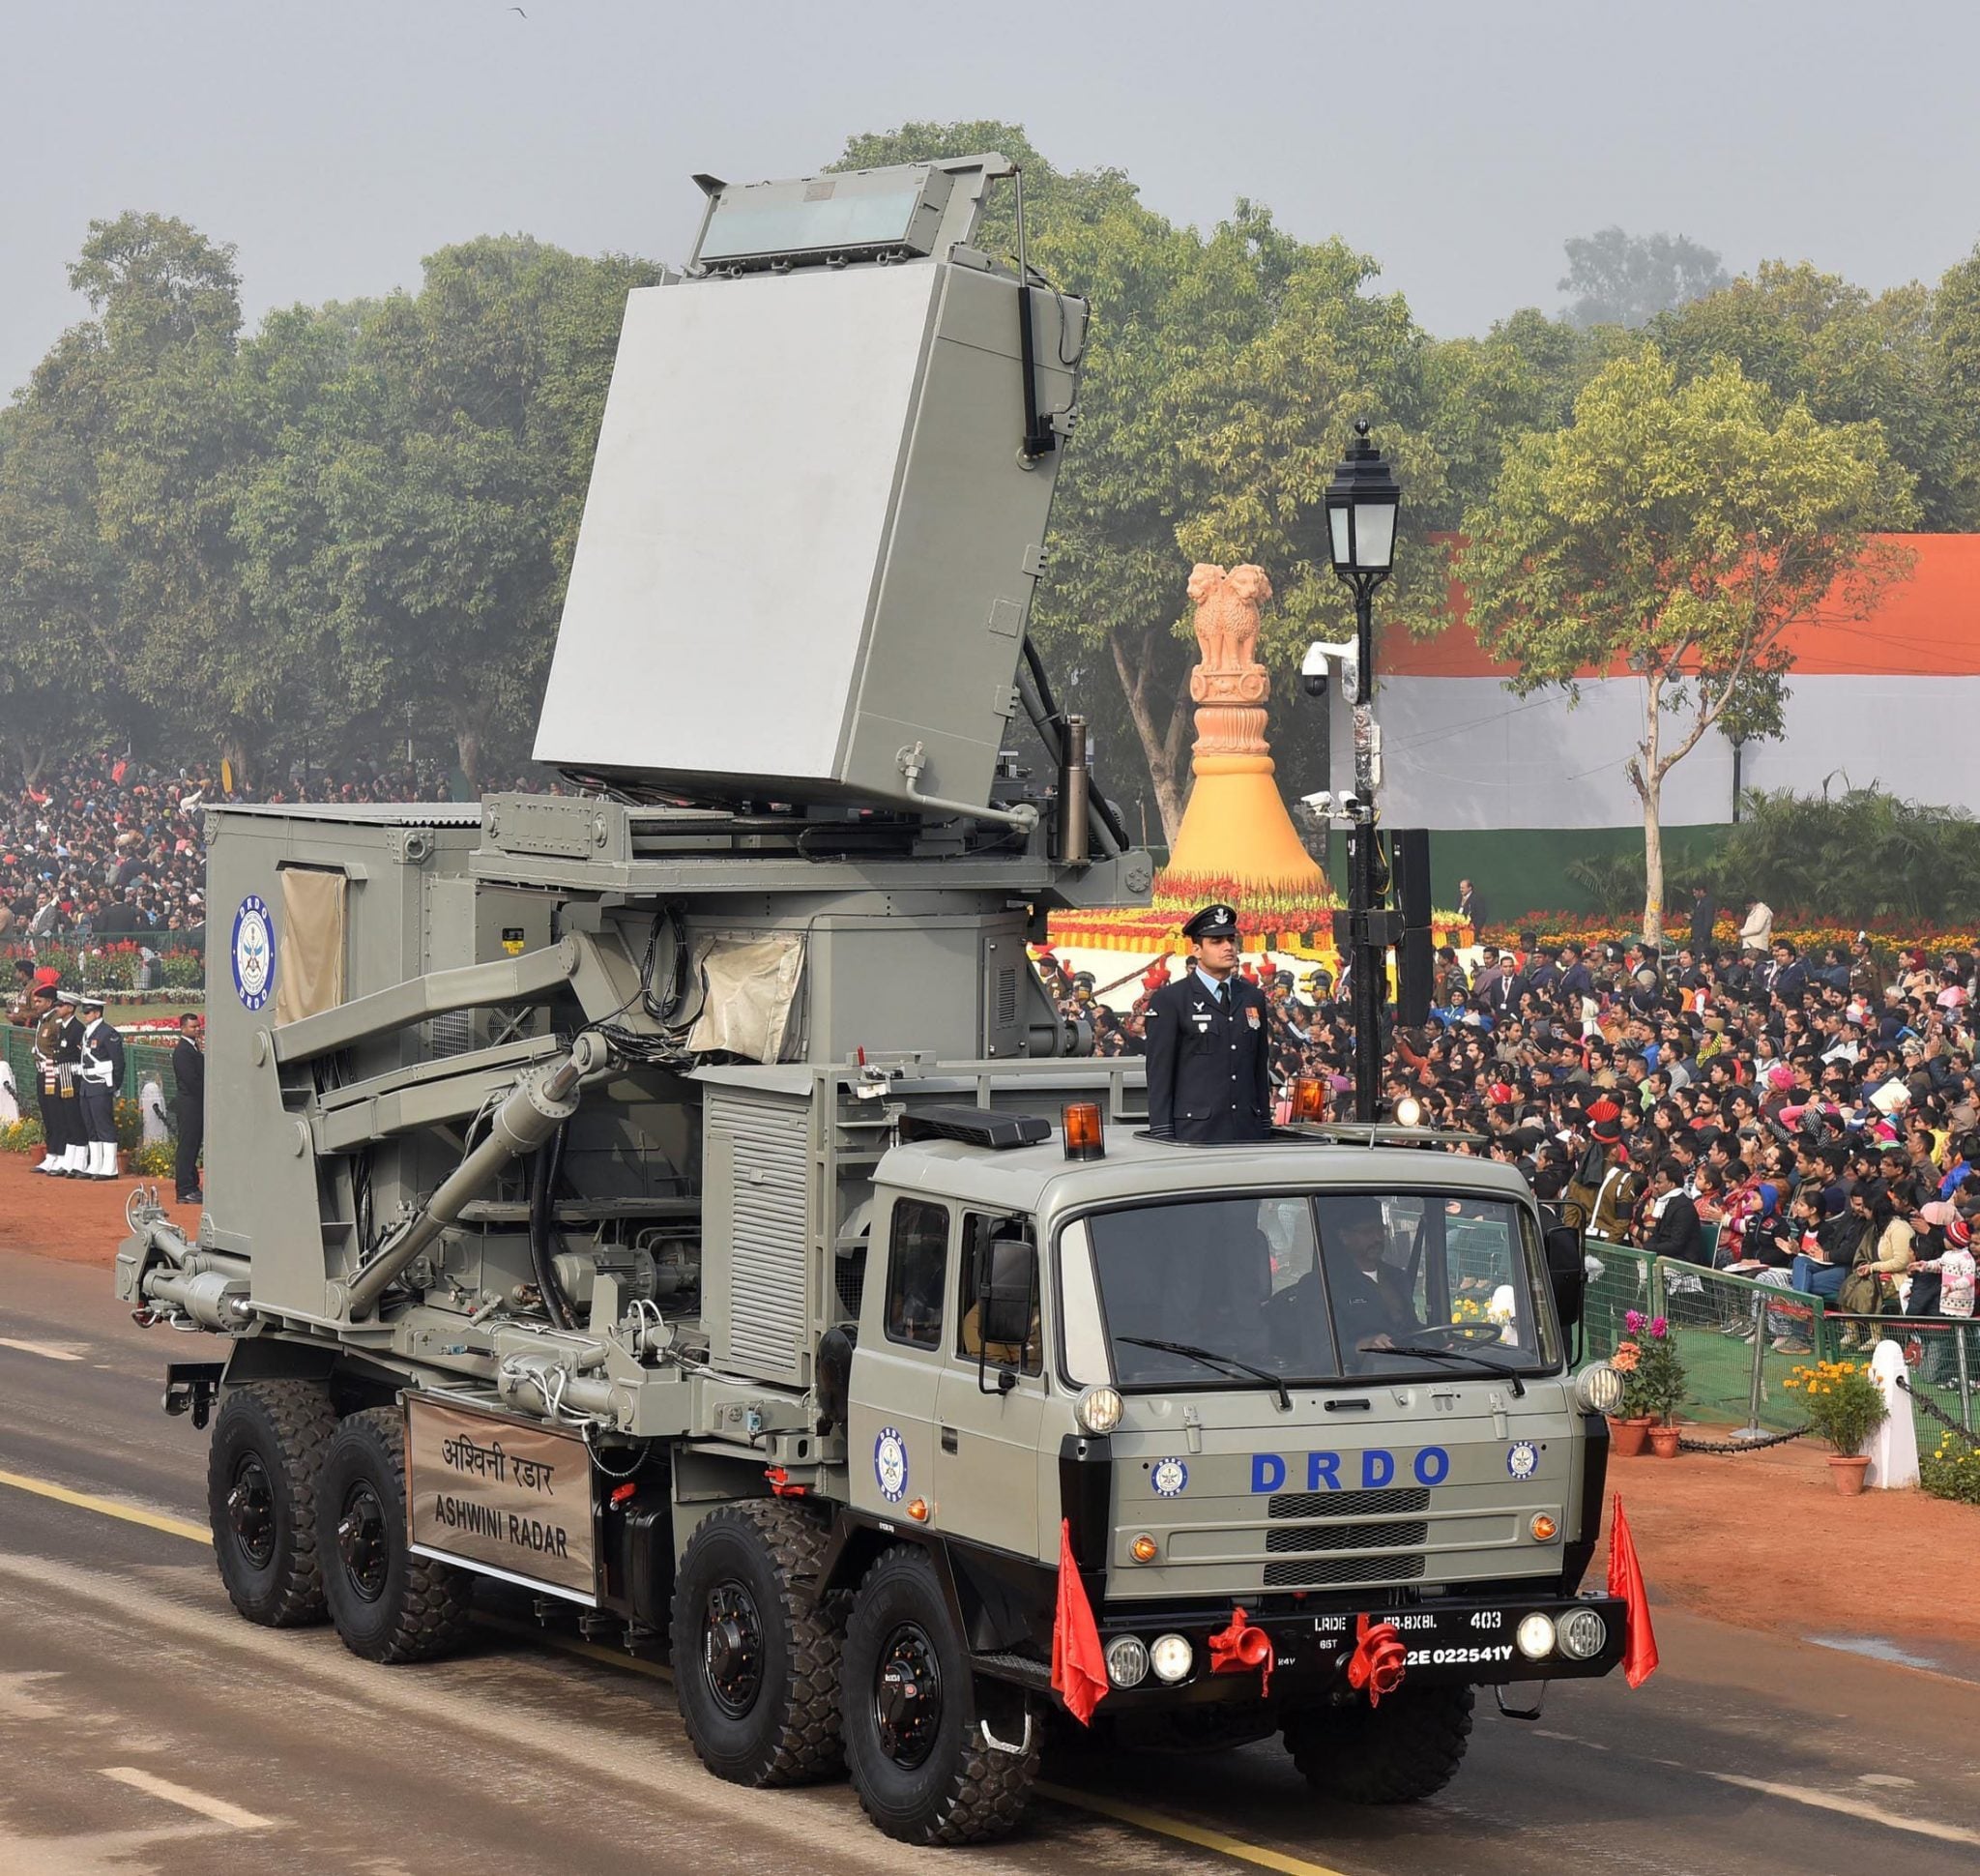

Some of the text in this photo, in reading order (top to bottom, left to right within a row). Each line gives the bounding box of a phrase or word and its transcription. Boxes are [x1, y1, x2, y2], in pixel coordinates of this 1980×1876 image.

[239, 897, 267, 919] DRDO
[239, 986, 267, 1009] DRDO
[442, 1433, 555, 1496] अश्विनी रडार
[1252, 1447, 1448, 1493] DRDO
[435, 1494, 568, 1559] ASHWINI RADAR
[1315, 1617, 1346, 1631] LRDE
[1470, 1611, 1501, 1628] 403
[1403, 1646, 1513, 1665] 2E 022541Y
